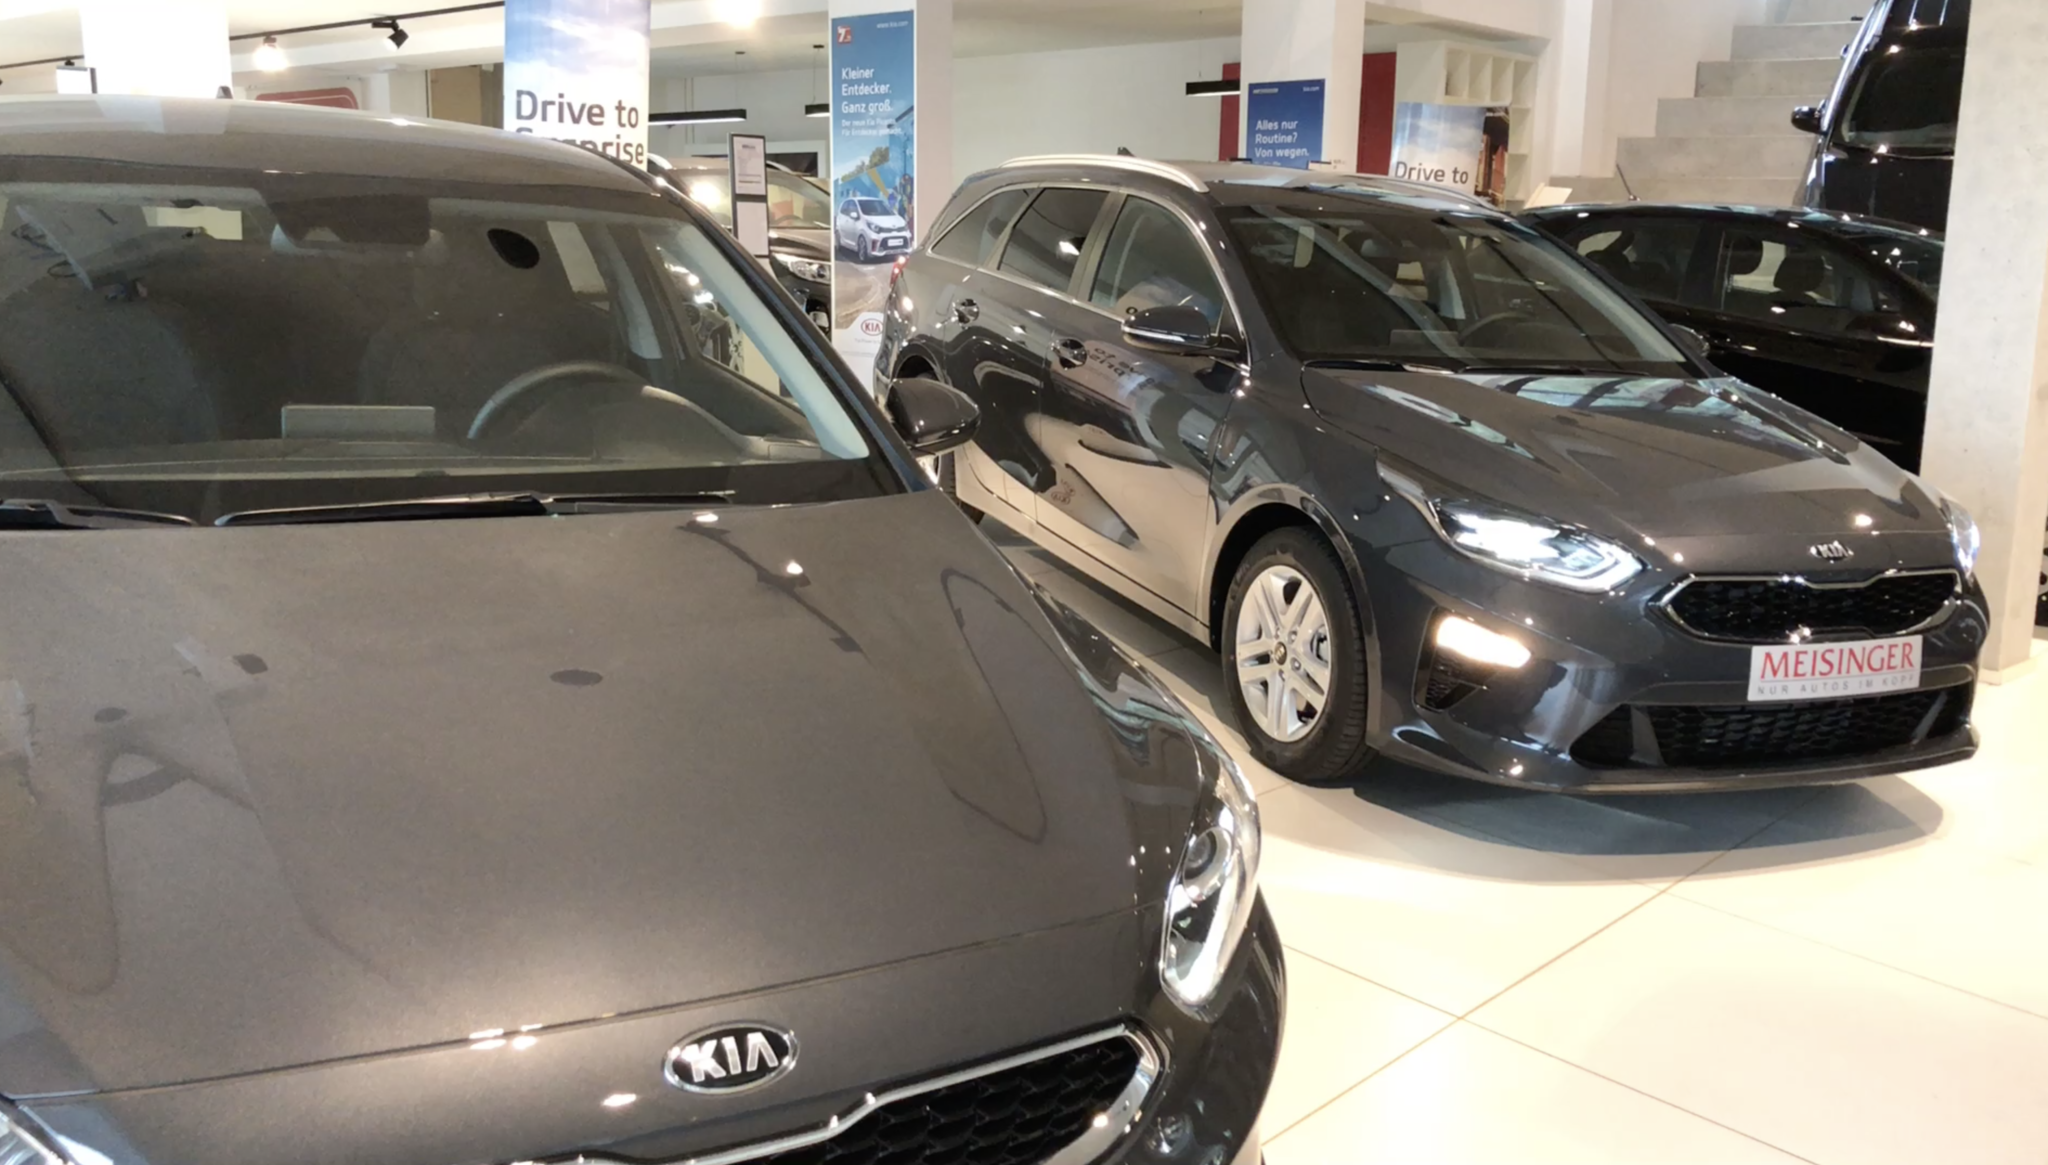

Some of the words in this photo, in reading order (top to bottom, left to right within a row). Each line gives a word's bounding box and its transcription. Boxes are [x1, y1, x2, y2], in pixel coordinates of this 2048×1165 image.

[841, 67, 875, 80] Kleiner
[841, 82, 892, 96] Entdecker.
[516, 89, 605, 126] Drive
[615, 99, 639, 128] to
[841, 101, 866, 114] Ganz
[1255, 119, 1279, 130] Alles
[1281, 120, 1298, 130] nur
[1254, 132, 1298, 144] Routine?
[1254, 147, 1273, 158] Von
[1275, 147, 1310, 159] wegen.
[1394, 161, 1446, 182] Drive
[1452, 167, 1469, 184] to
[864, 322, 881, 332] KIA
[1817, 540, 1849, 558] KIA
[1760, 642, 1915, 681] MEISINGER
[1757, 684, 1789, 696] NUR
[1800, 680, 1849, 693] AUTOS
[1858, 678, 1874, 689] IM
[1882, 674, 1915, 687] KOPF
[680, 1031, 779, 1083] KIA
